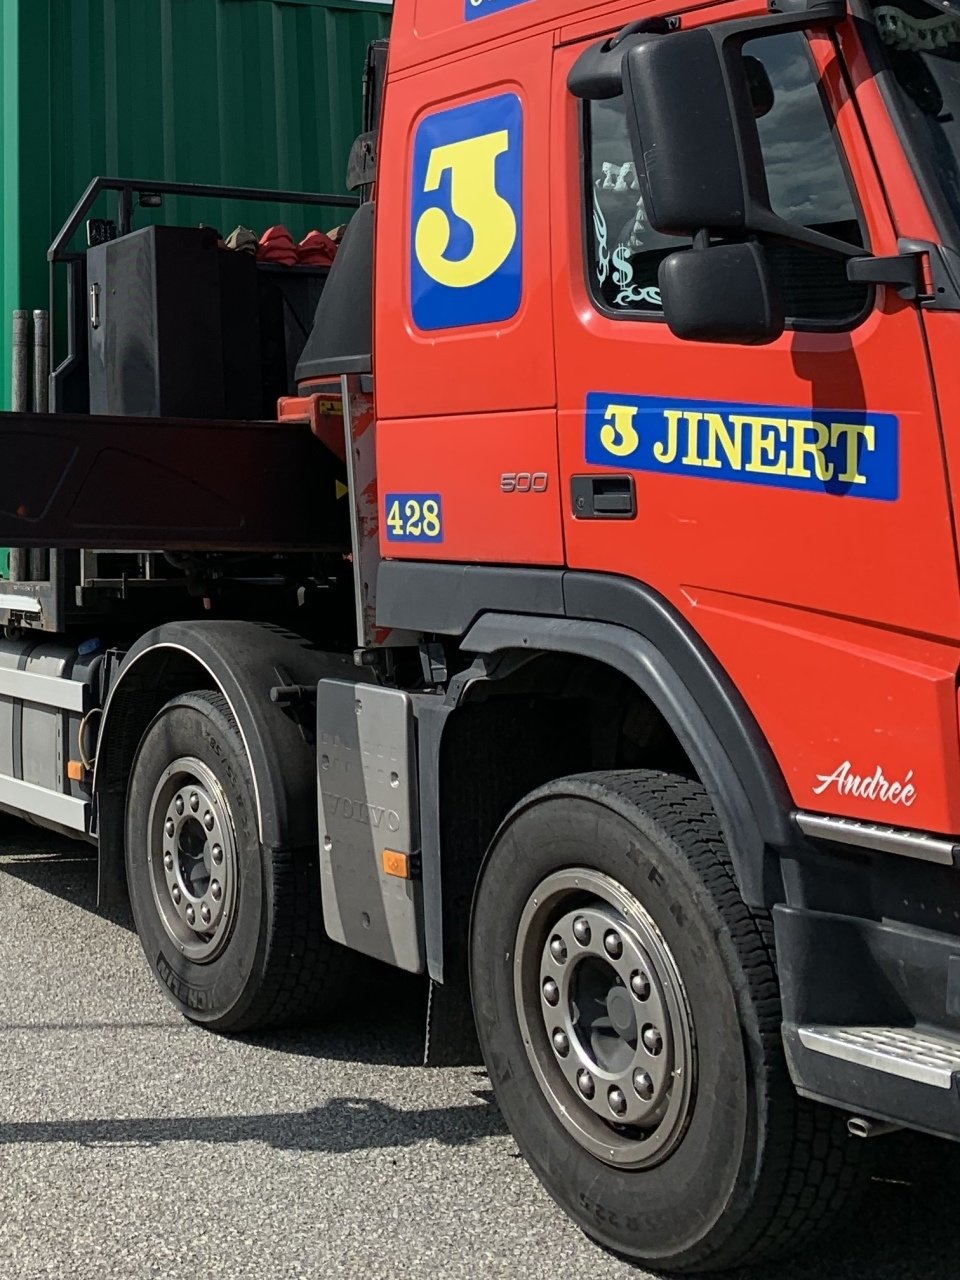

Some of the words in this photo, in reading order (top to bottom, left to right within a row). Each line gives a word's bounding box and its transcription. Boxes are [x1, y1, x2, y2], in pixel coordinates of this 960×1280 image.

[653, 410, 876, 485] JINERT
[500, 472, 548, 493] 500
[386, 500, 441, 537] 428
[811, 760, 918, 807] Andreé
[321, 791, 400, 833] VOLVO
[157, 960, 219, 1010] ICHELIN
